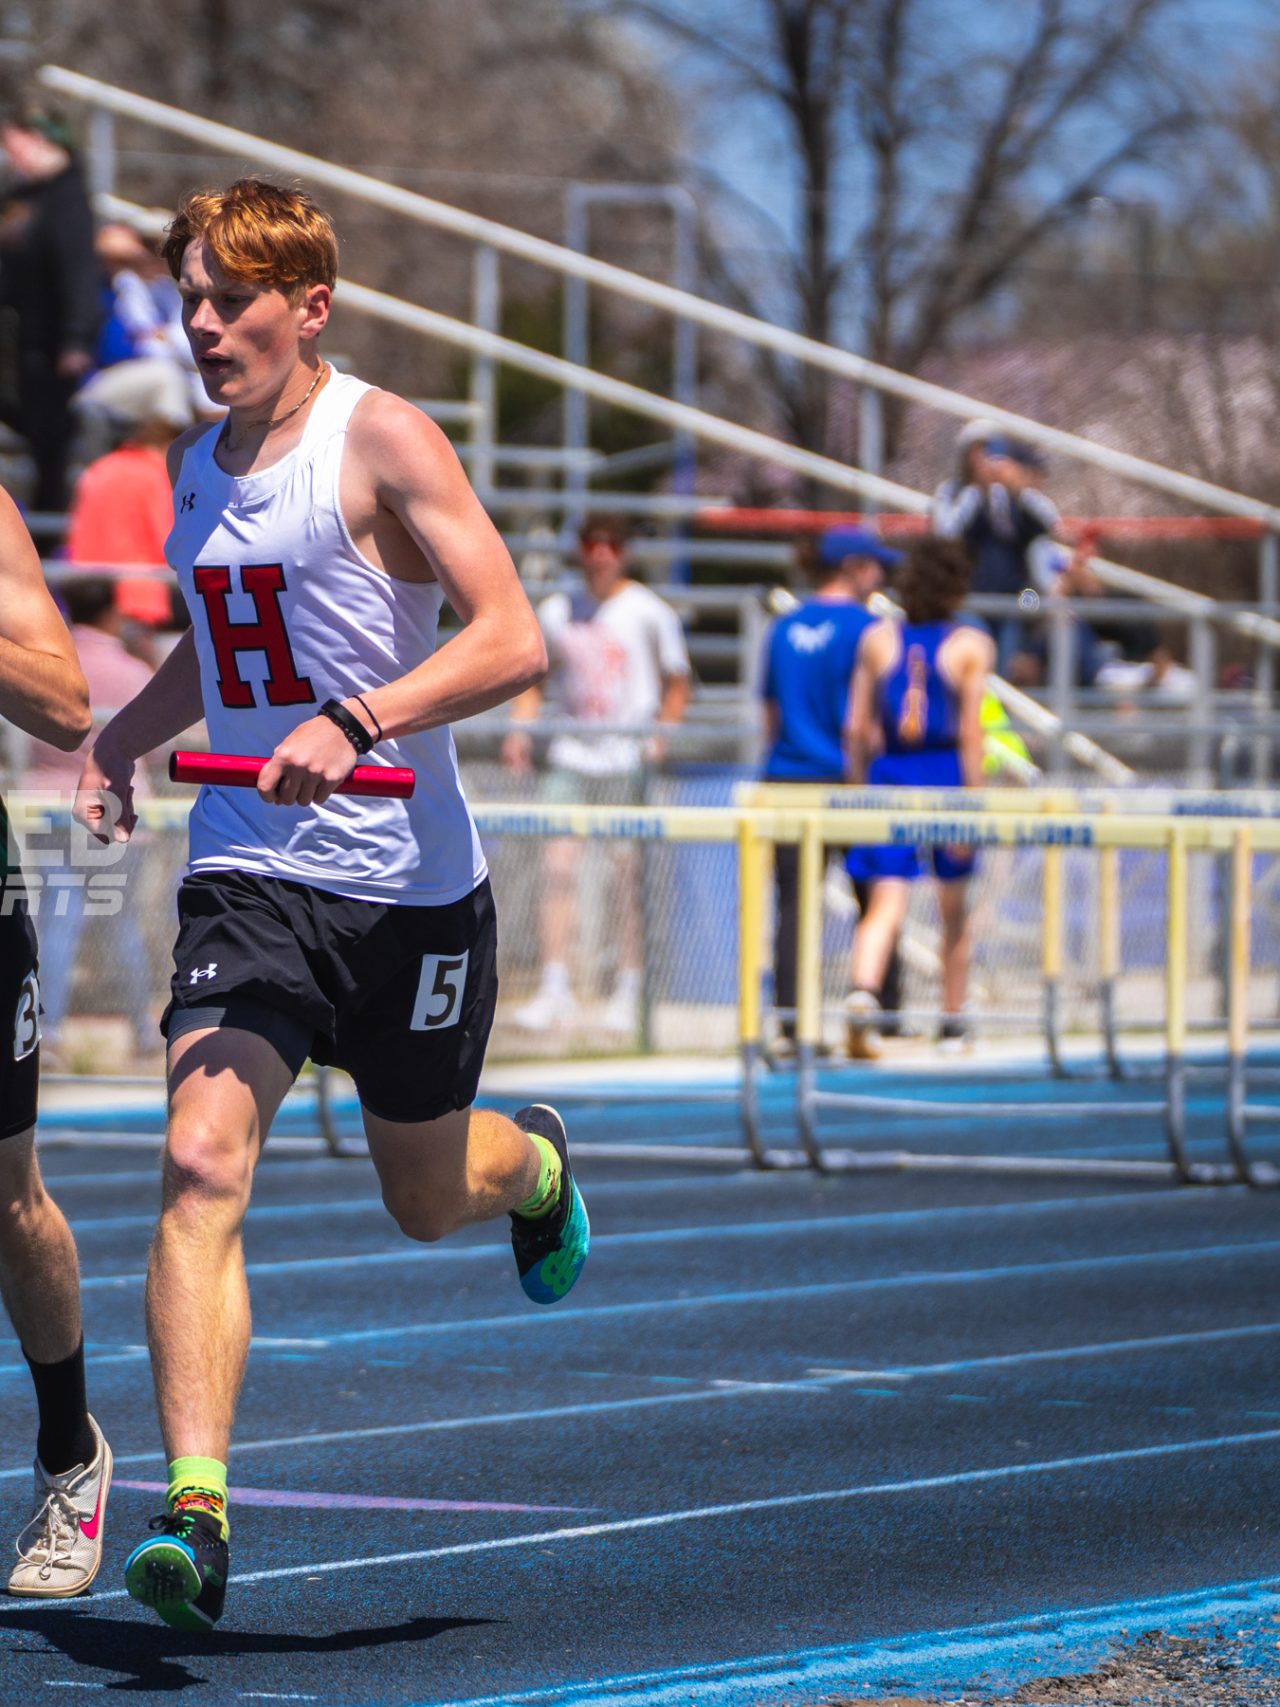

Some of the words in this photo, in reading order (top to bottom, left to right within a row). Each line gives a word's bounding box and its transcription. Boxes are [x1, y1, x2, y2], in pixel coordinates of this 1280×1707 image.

[193, 563, 317, 708] H
[21, 980, 37, 1053] 3
[424, 958, 464, 1027] 5
